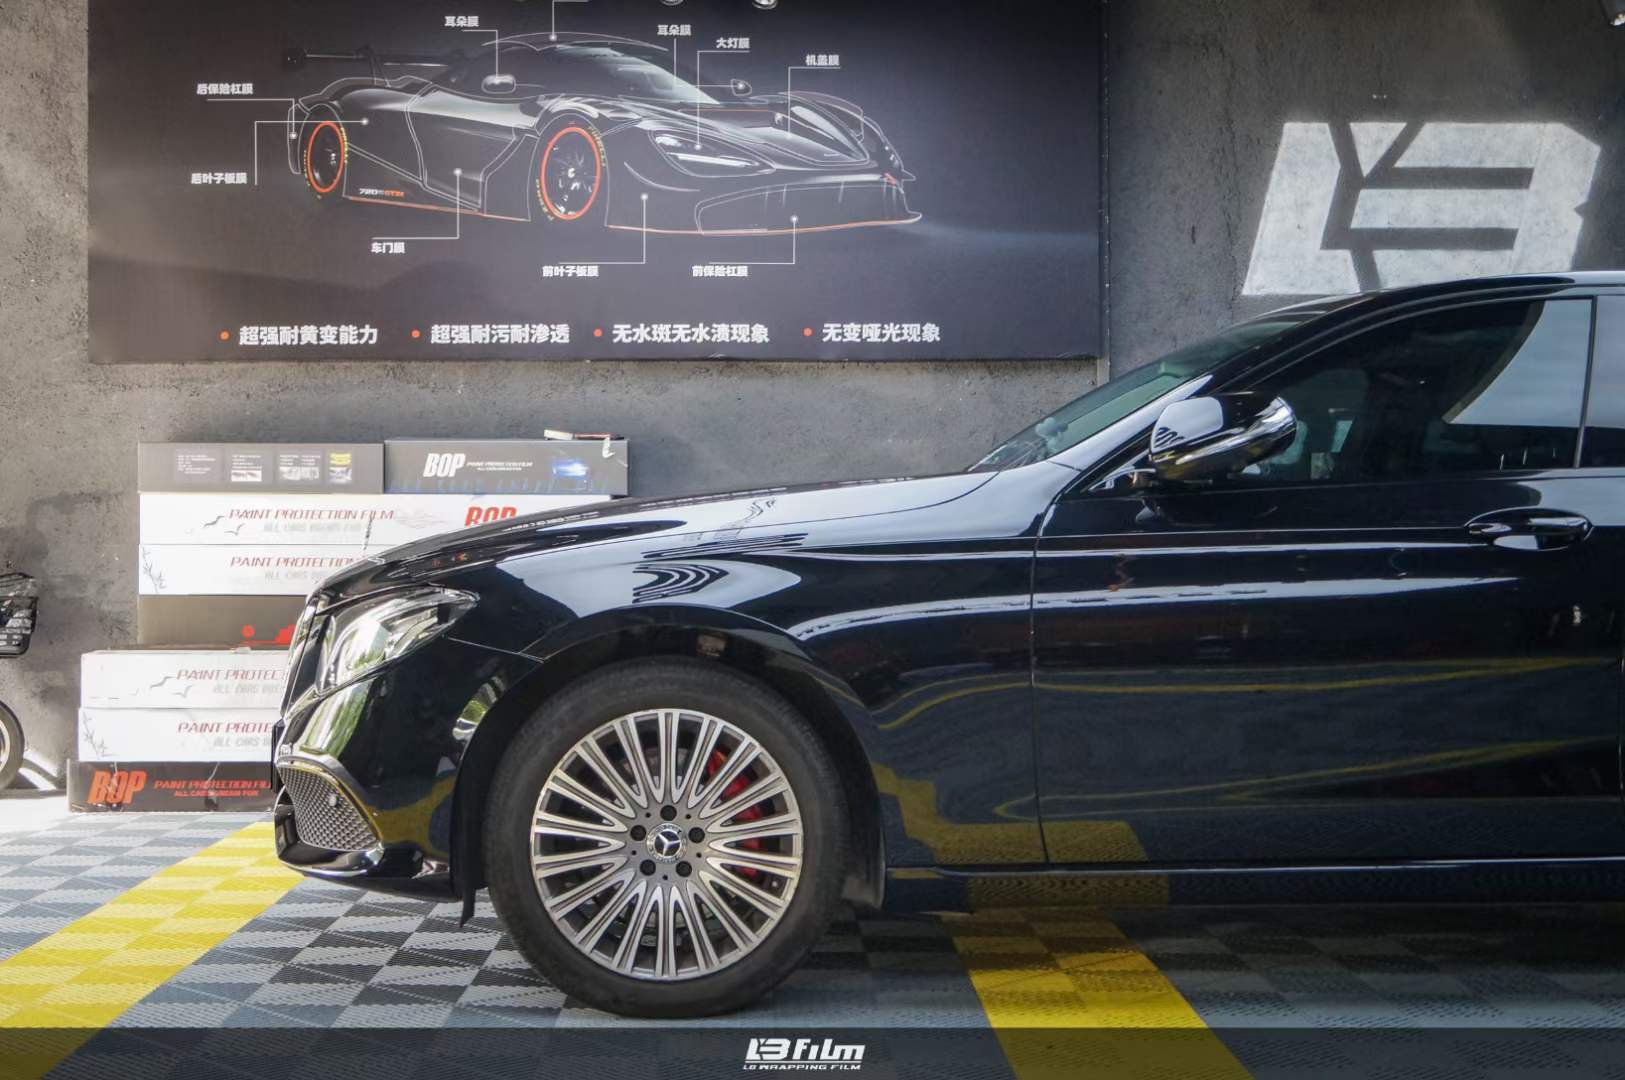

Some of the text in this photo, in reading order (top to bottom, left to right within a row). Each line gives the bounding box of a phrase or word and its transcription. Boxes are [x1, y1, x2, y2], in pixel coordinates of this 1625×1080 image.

[444, 15, 479, 27] 耳朵膜
[657, 24, 692, 36] 耳朵膜
[716, 37, 750, 49] 大灯膜
[805, 54, 840, 67] 机盖膜
[196, 82, 254, 95] 后保险杠膜
[371, 242, 406, 254] 车门膜
[542, 265, 599, 278] 前叶子板膜
[692, 265, 749, 278] 前保险杠膜
[239, 325, 378, 346] 超强耐黄变能力
[430, 323, 570, 344] 超强耐污耐渗透
[822, 322, 941, 343] 无变哑光现象
[423, 453, 466, 477] BOP
[229, 509, 395, 520] PAINT PROTECTION FILM
[230, 557, 273, 567] PAINT
[177, 669, 222, 680] PAINT
[177, 722, 223, 733] PAINT
[87, 770, 147, 805] BOP
[154, 780, 186, 789] PAINT
